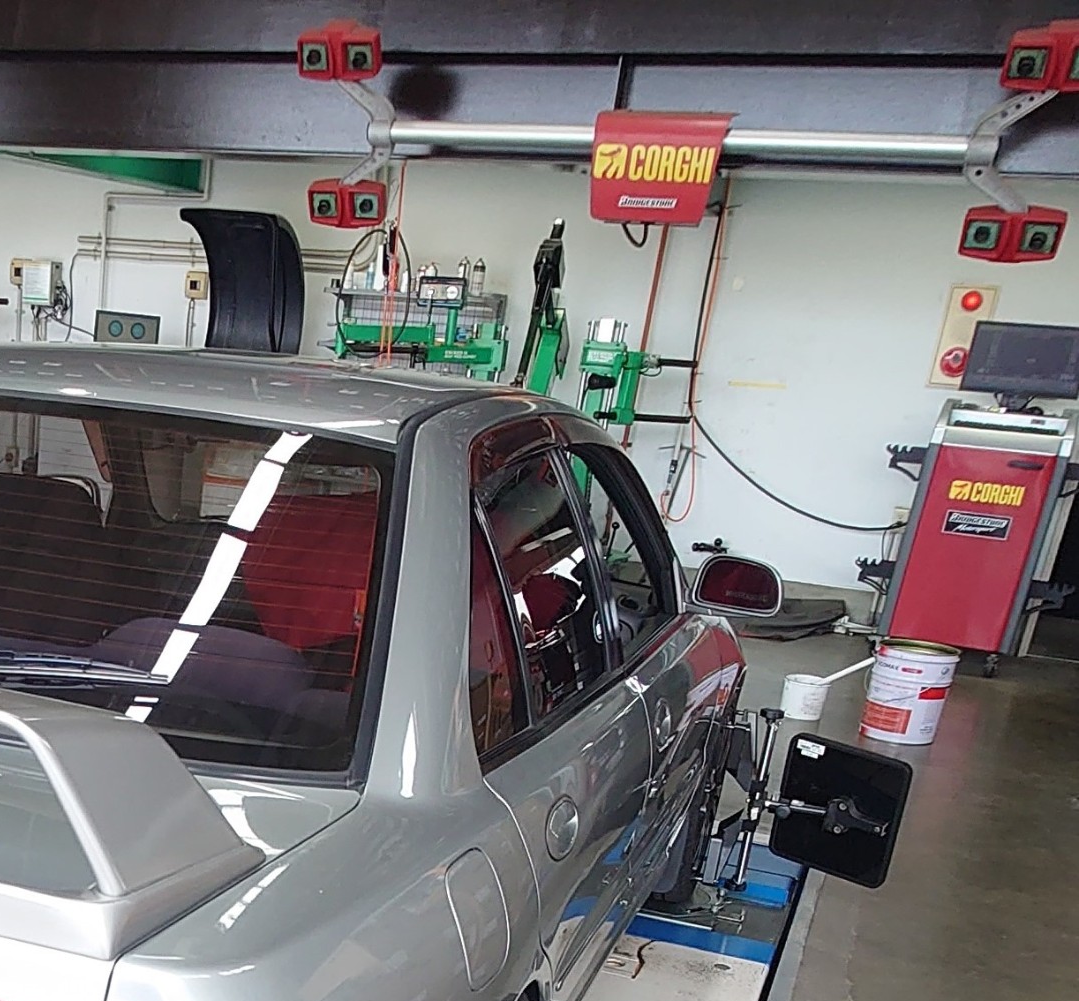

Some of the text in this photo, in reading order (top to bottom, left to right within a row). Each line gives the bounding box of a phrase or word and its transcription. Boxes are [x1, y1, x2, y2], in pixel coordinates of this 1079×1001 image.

[628, 144, 716, 184] CORGHI
[619, 195, 677, 209] BRIDGESTONE
[970, 482, 1026, 507] CORGHI
